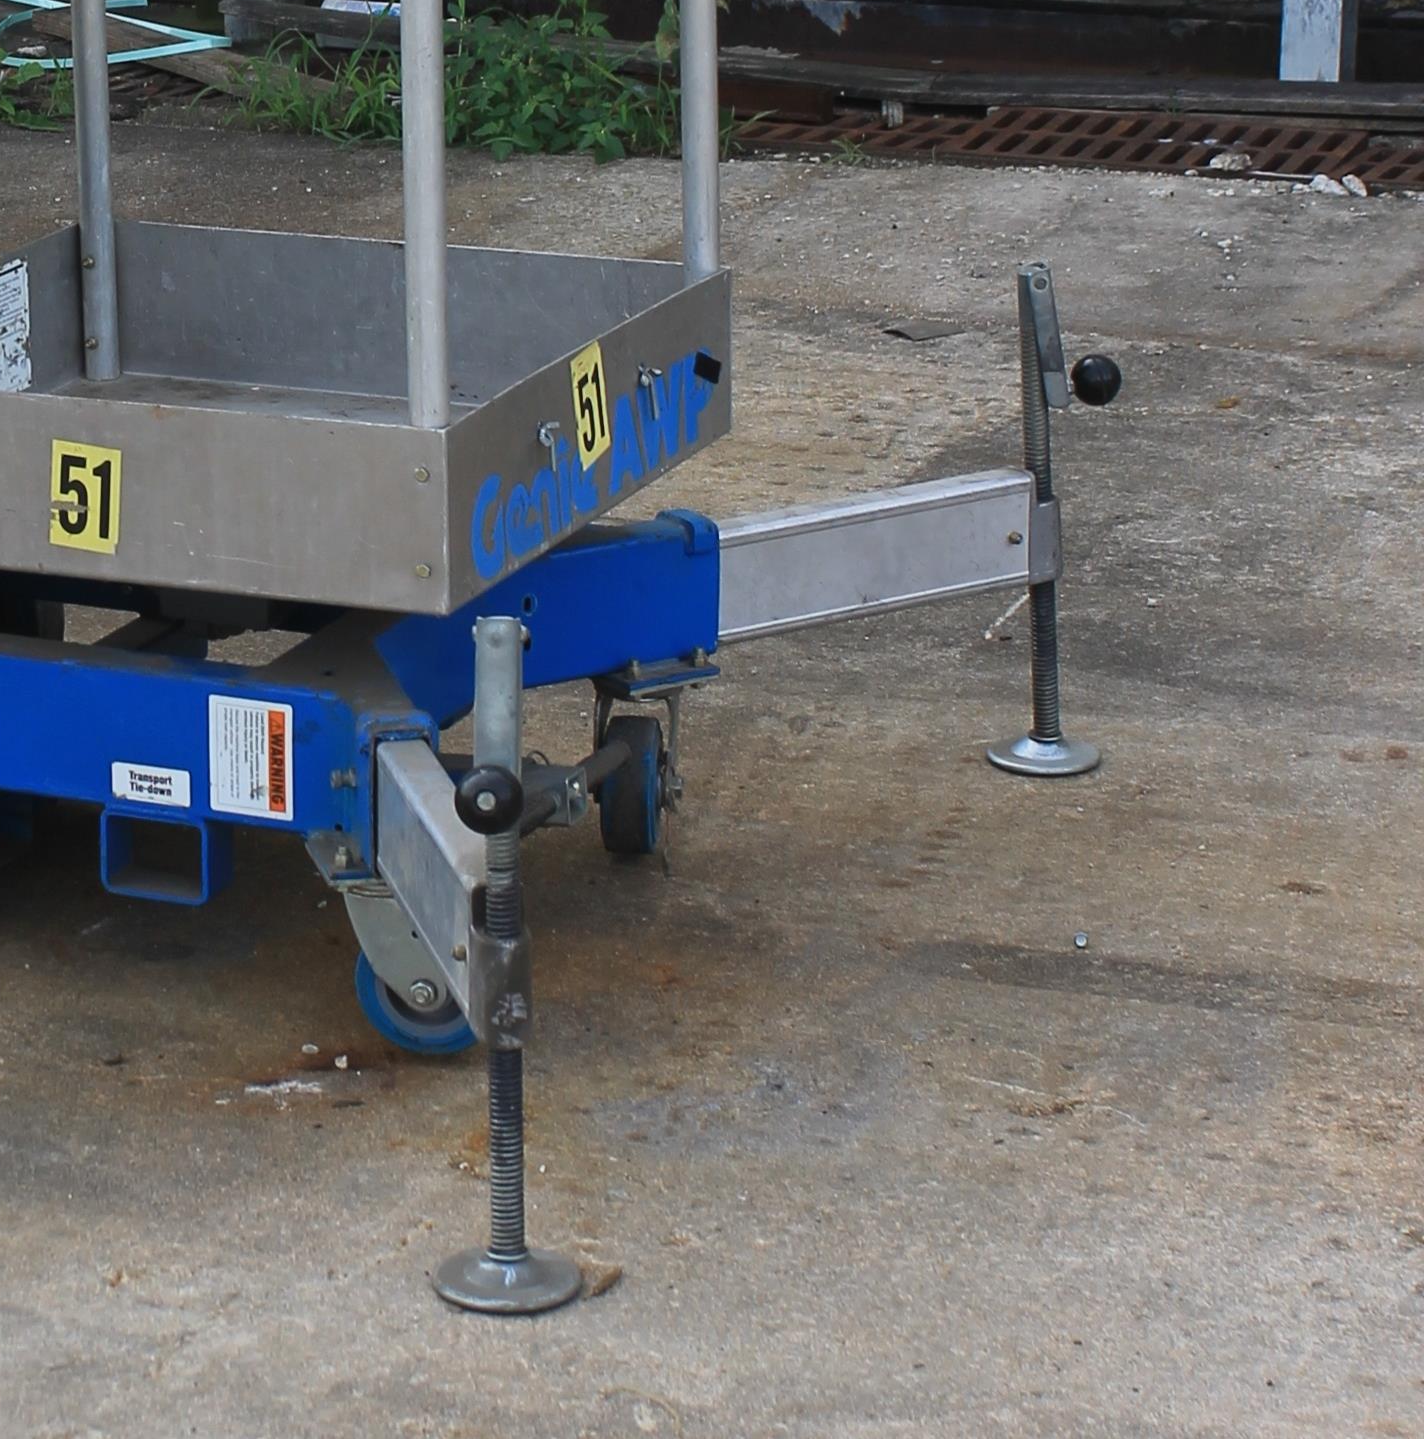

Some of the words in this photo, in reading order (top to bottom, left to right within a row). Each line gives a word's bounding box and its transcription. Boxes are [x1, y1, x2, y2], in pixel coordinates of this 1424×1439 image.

[577, 362, 606, 452] 51
[58, 453, 112, 540] 51
[128, 769, 173, 786] Transport
[129, 781, 173, 797] Tie-down
[270, 733, 285, 806] WARNING
